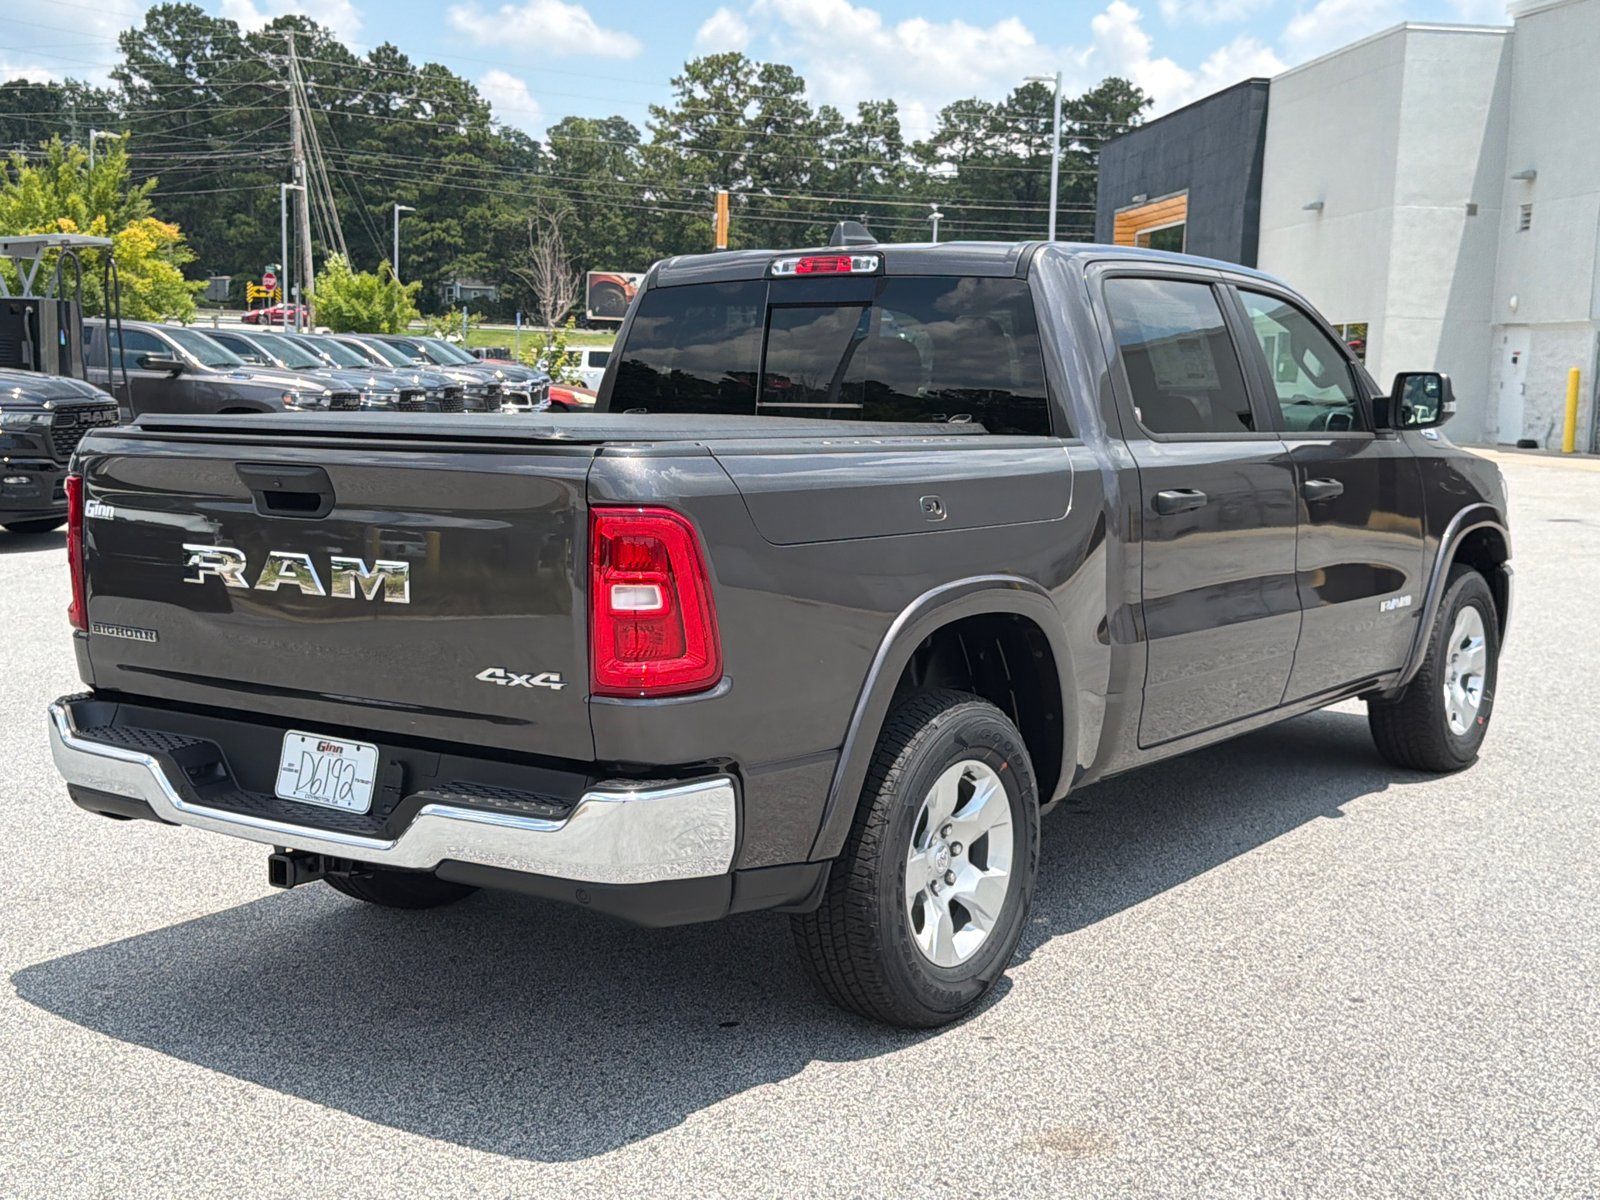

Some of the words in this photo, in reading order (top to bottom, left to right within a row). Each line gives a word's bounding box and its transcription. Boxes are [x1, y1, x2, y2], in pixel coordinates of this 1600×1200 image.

[79, 411, 112, 422] RAM
[84, 500, 115, 518] Ginn
[183, 543, 410, 603] RAM
[1380, 595, 1412, 612] RAM
[92, 624, 157, 641] BIGHORN
[475, 667, 568, 690] 4x4
[316, 740, 344, 753] Ginn
[295, 751, 355, 801] D6192
